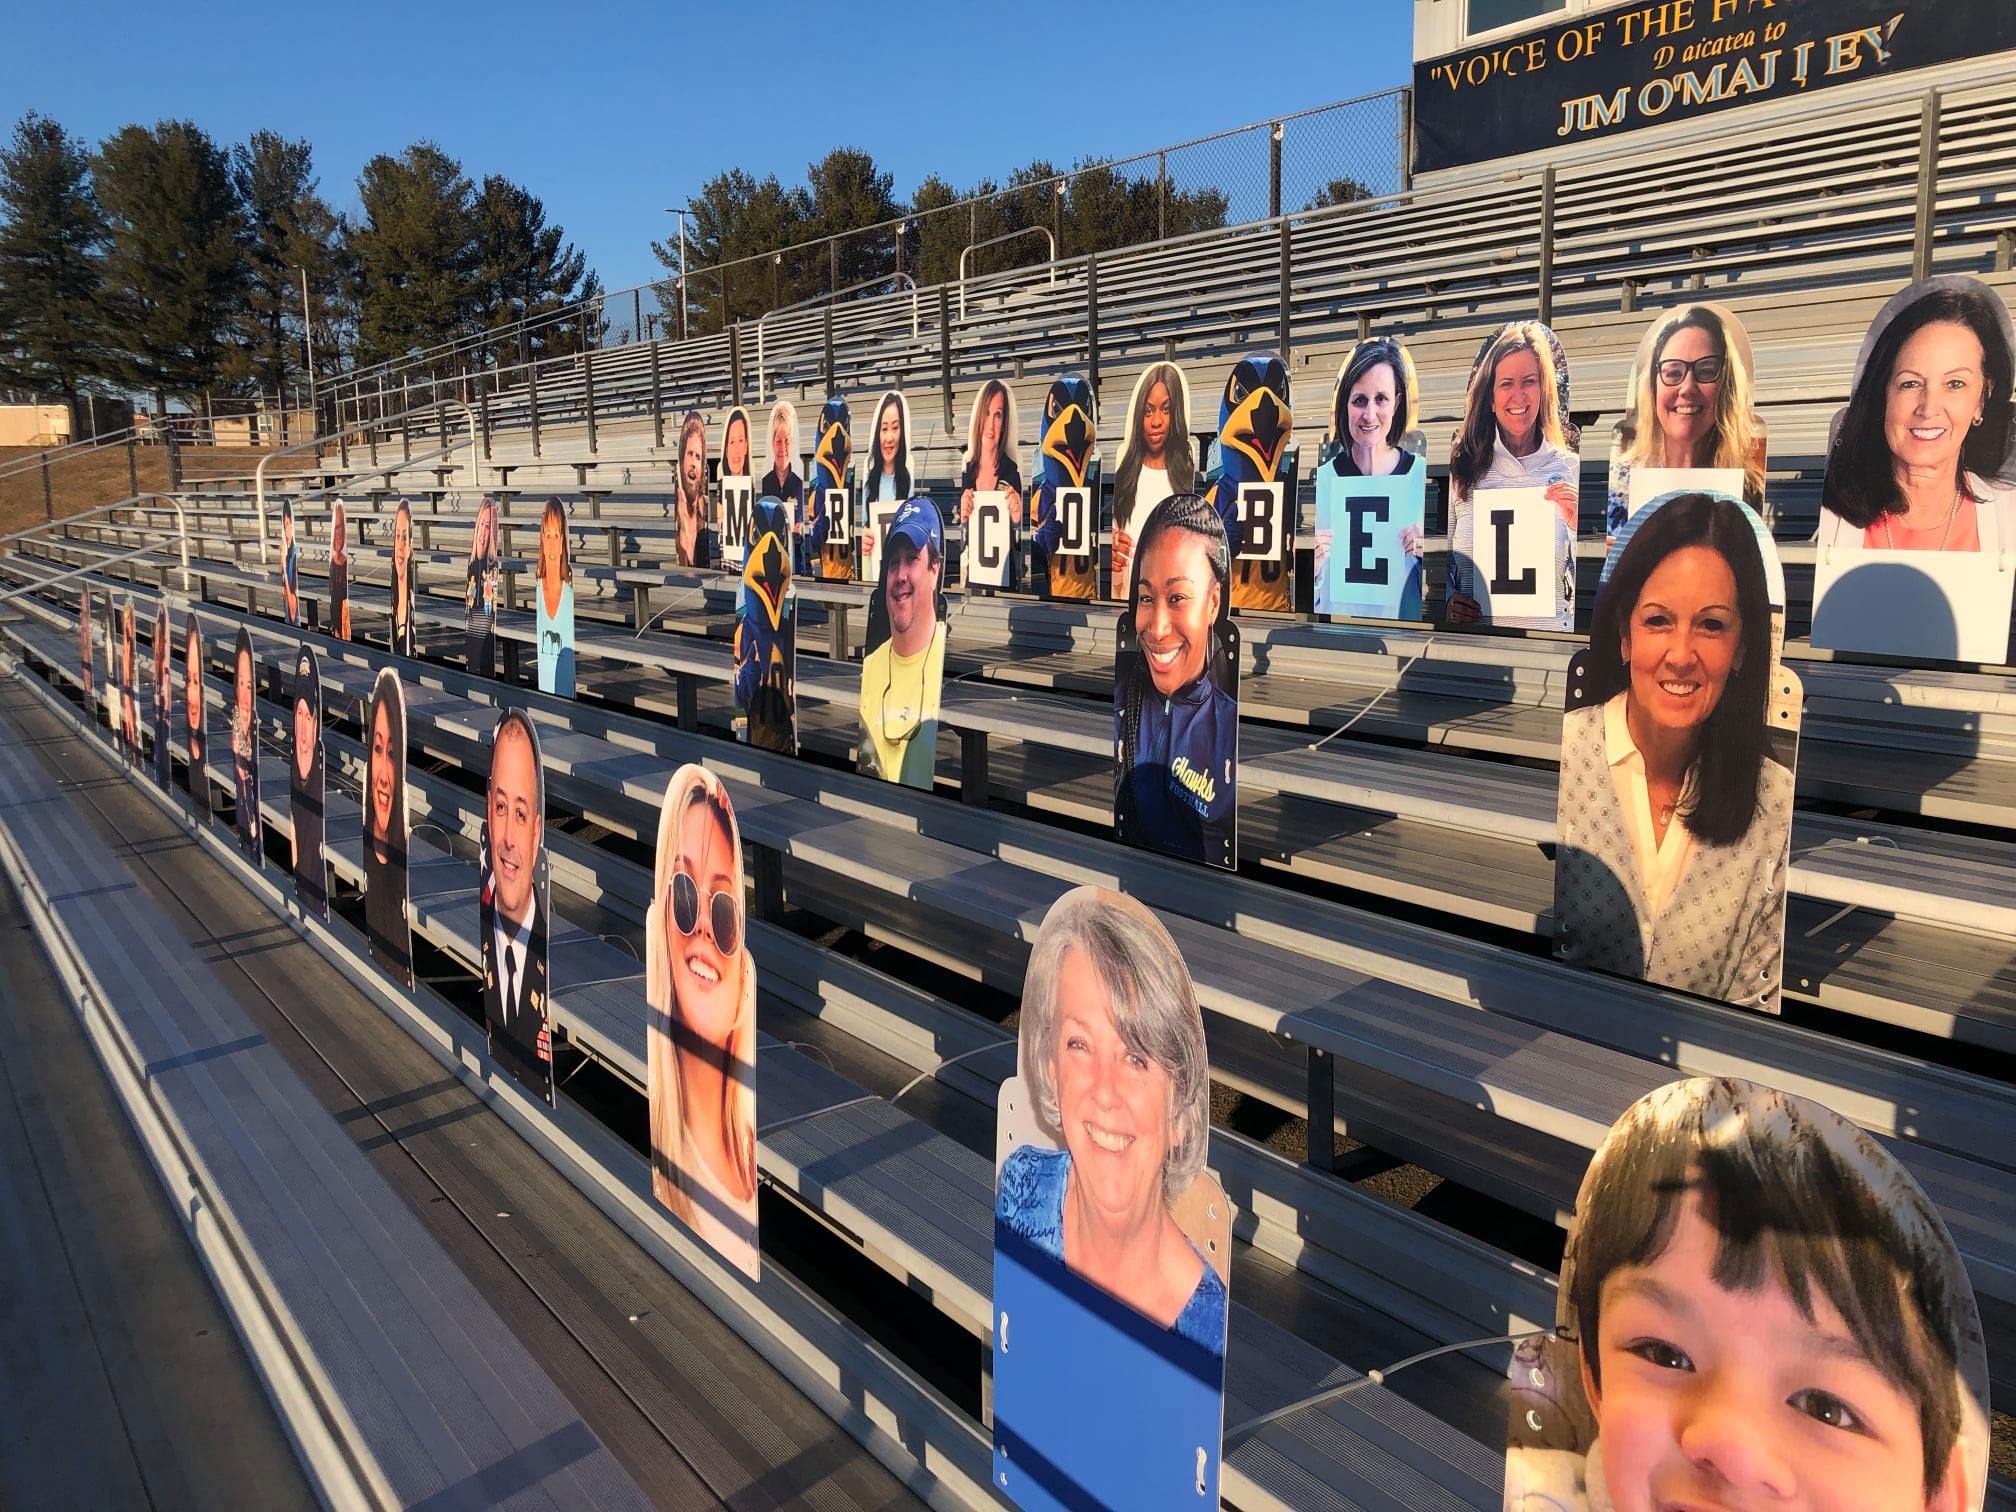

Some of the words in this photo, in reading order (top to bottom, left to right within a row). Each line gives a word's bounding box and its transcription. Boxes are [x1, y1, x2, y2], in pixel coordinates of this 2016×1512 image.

[1557, 22, 1606, 62] OF
[1617, 0, 1697, 47] THE
[1763, 21, 1787, 43] to
[1557, 86, 1632, 136] JIM
[725, 489, 749, 547] M
[830, 493, 844, 540] R
[978, 505, 1000, 569] C
[1242, 489, 1275, 555] B
[1345, 496, 1390, 586] E
[1490, 509, 1536, 596] L
[1171, 756, 1216, 803] Hawks
